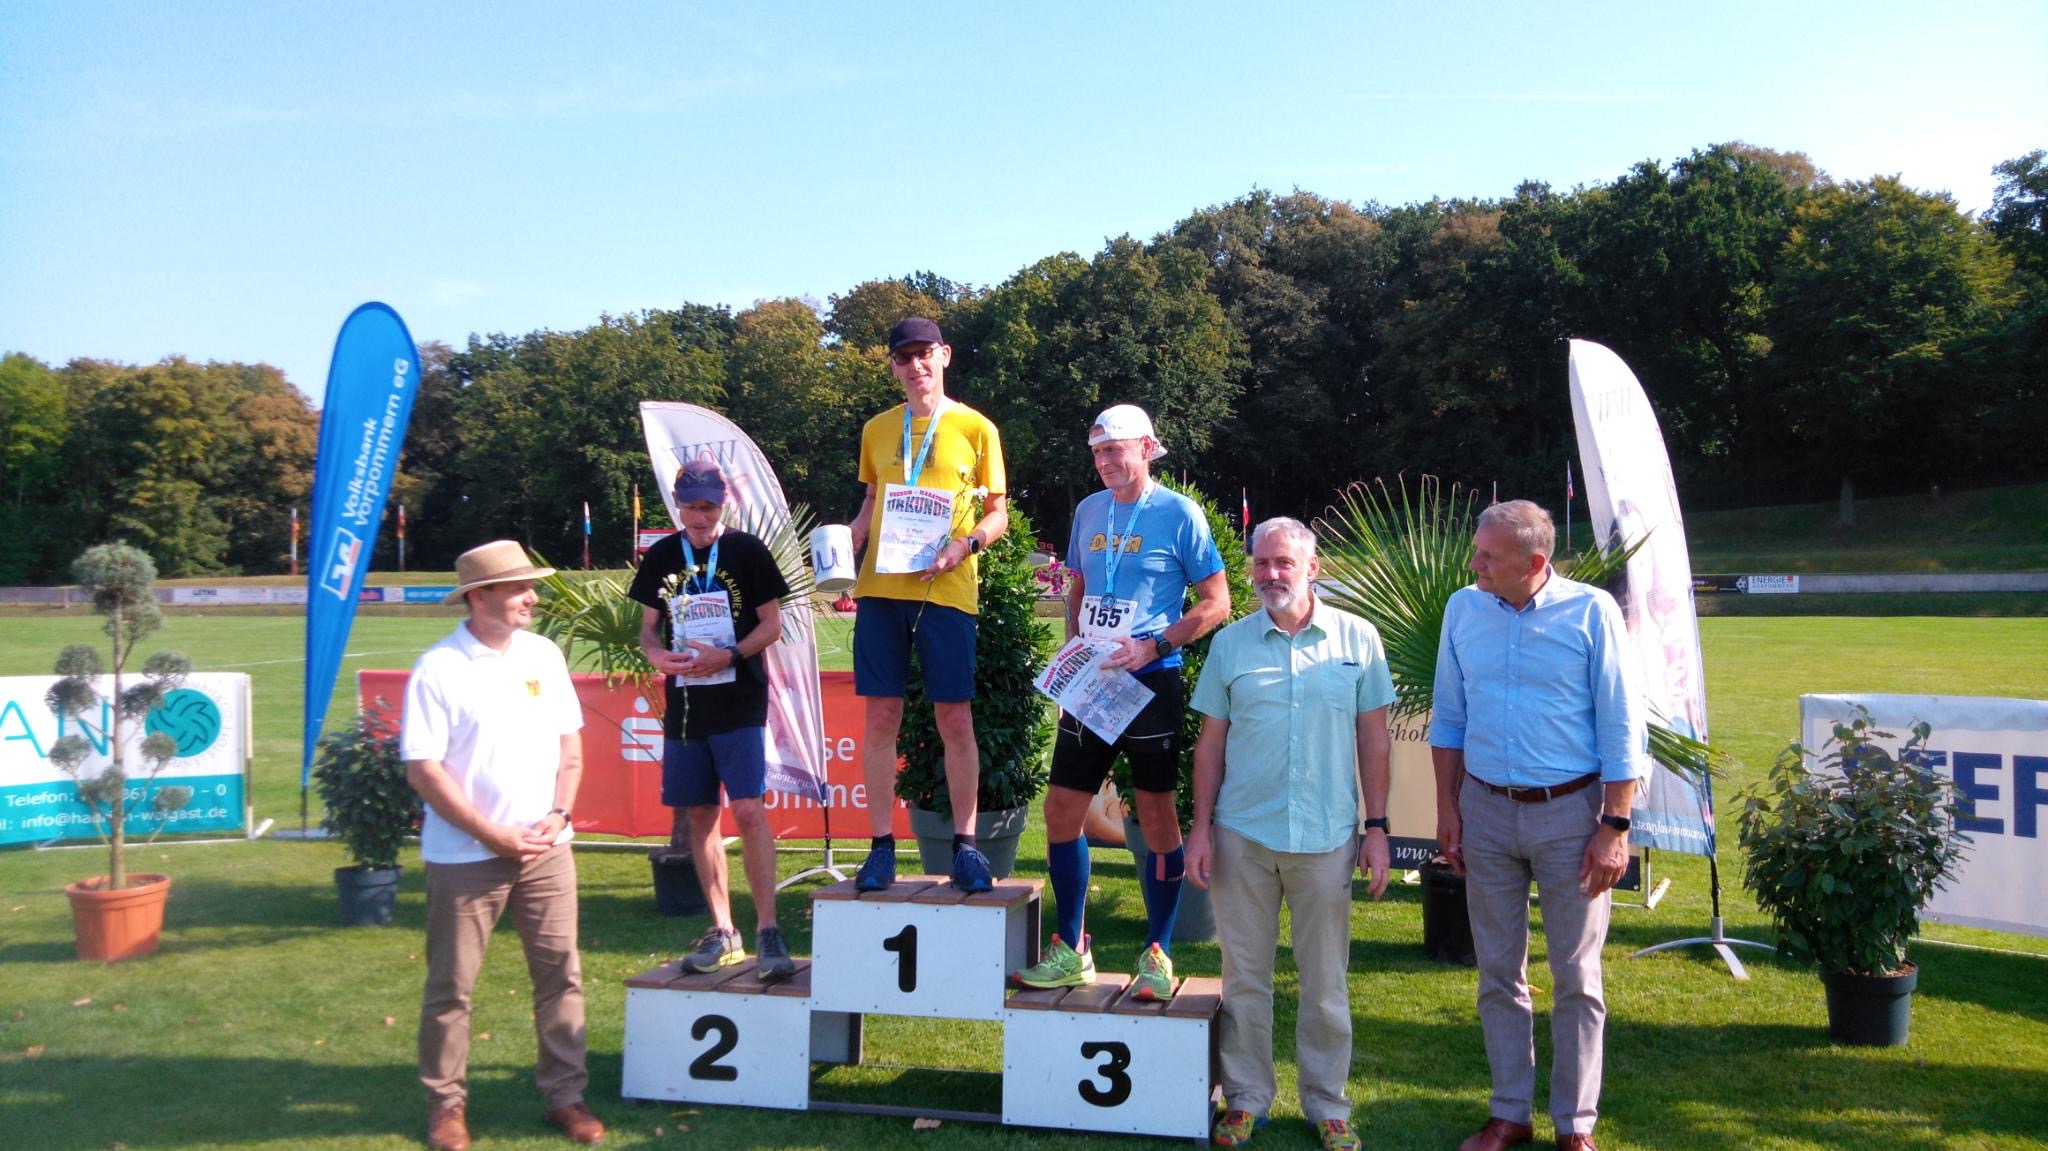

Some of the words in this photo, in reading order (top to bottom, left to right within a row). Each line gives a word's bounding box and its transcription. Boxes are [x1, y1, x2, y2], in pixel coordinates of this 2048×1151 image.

[342, 416, 377, 519] Volksbank
[355, 393, 401, 525] Vorpommern
[393, 358, 410, 388] eG
[886, 496, 951, 519] URKUNDE
[725, 578, 743, 610] ALONE
[1088, 605, 1123, 629] 155
[5, 790, 75, 808] Telefon:
[883, 924, 918, 993] 1
[689, 1014, 739, 1081] 2
[1078, 1041, 1132, 1107] 3
